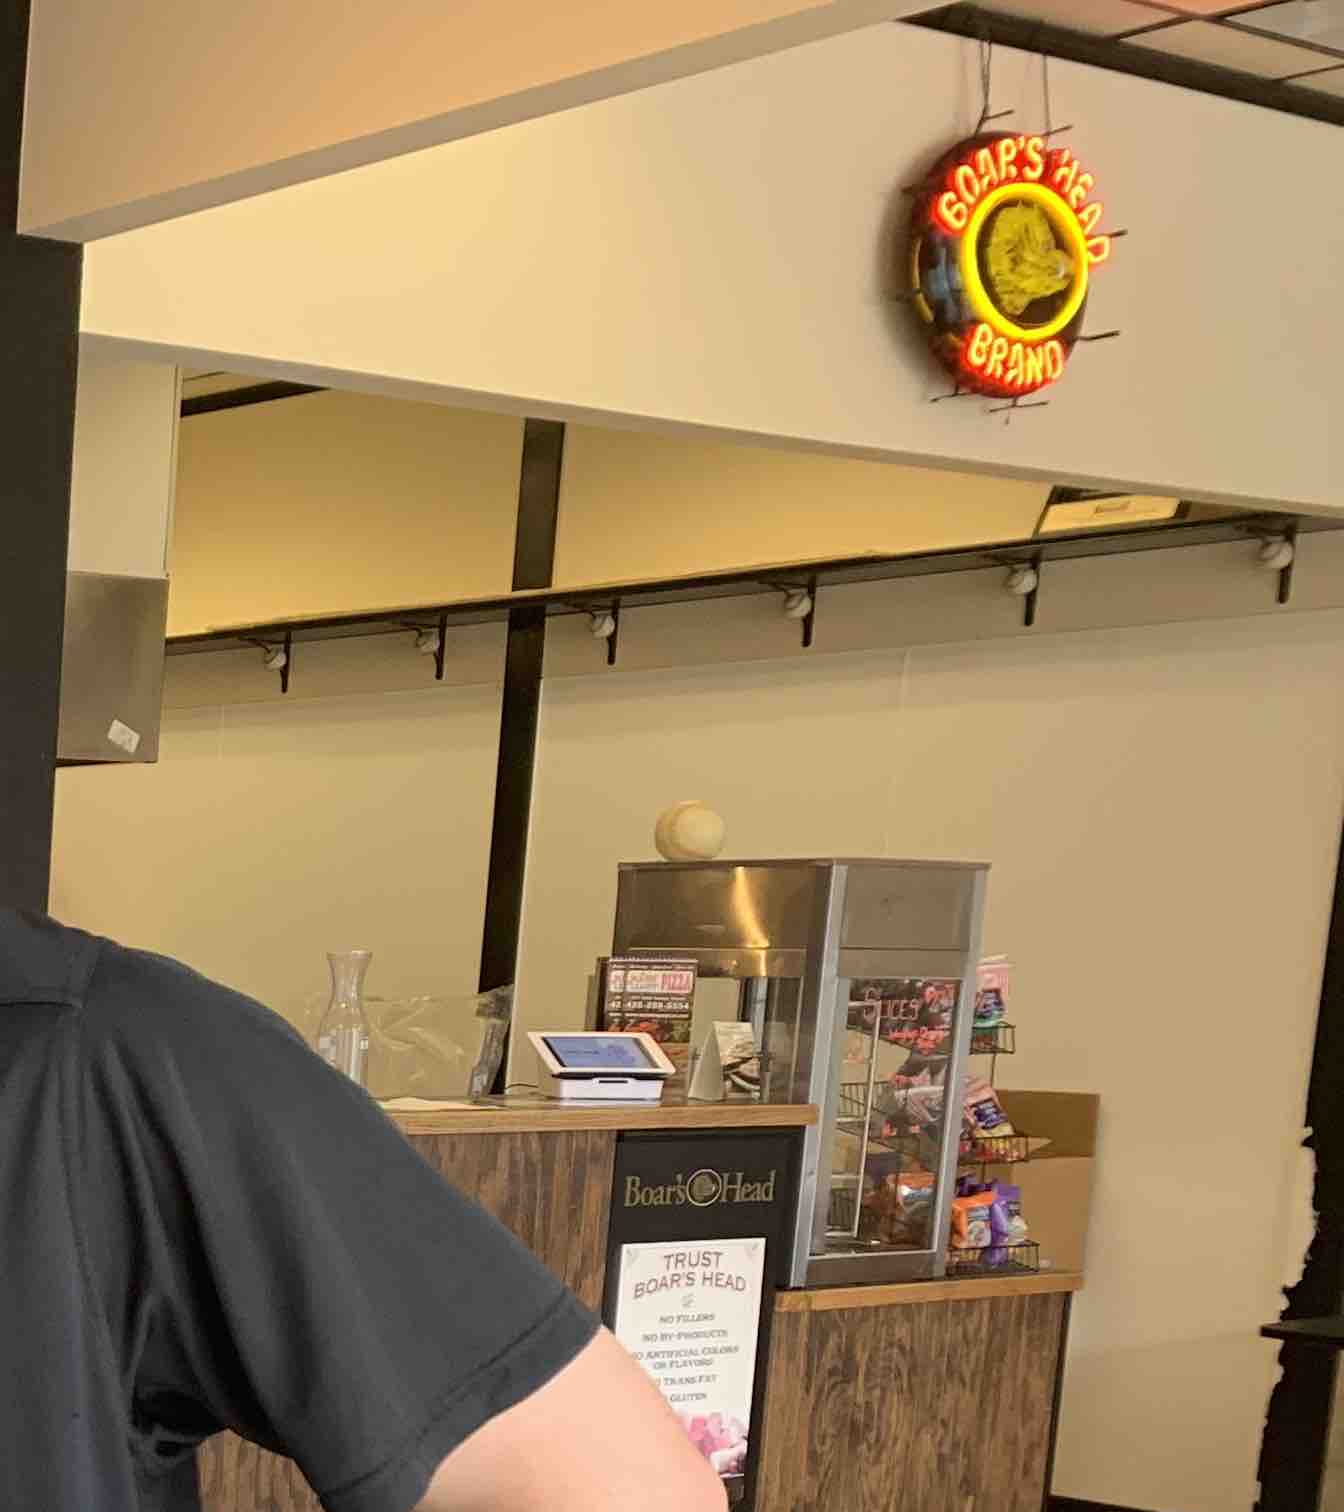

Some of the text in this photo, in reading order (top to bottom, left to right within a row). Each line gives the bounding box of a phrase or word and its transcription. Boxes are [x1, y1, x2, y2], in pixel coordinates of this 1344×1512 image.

[969, 322, 1064, 385] BRAND
[623, 1170, 776, 1207] Boar's Head
[663, 1251, 723, 1270] TRUST
[633, 1272, 746, 1299] BOAR'S HEAD
